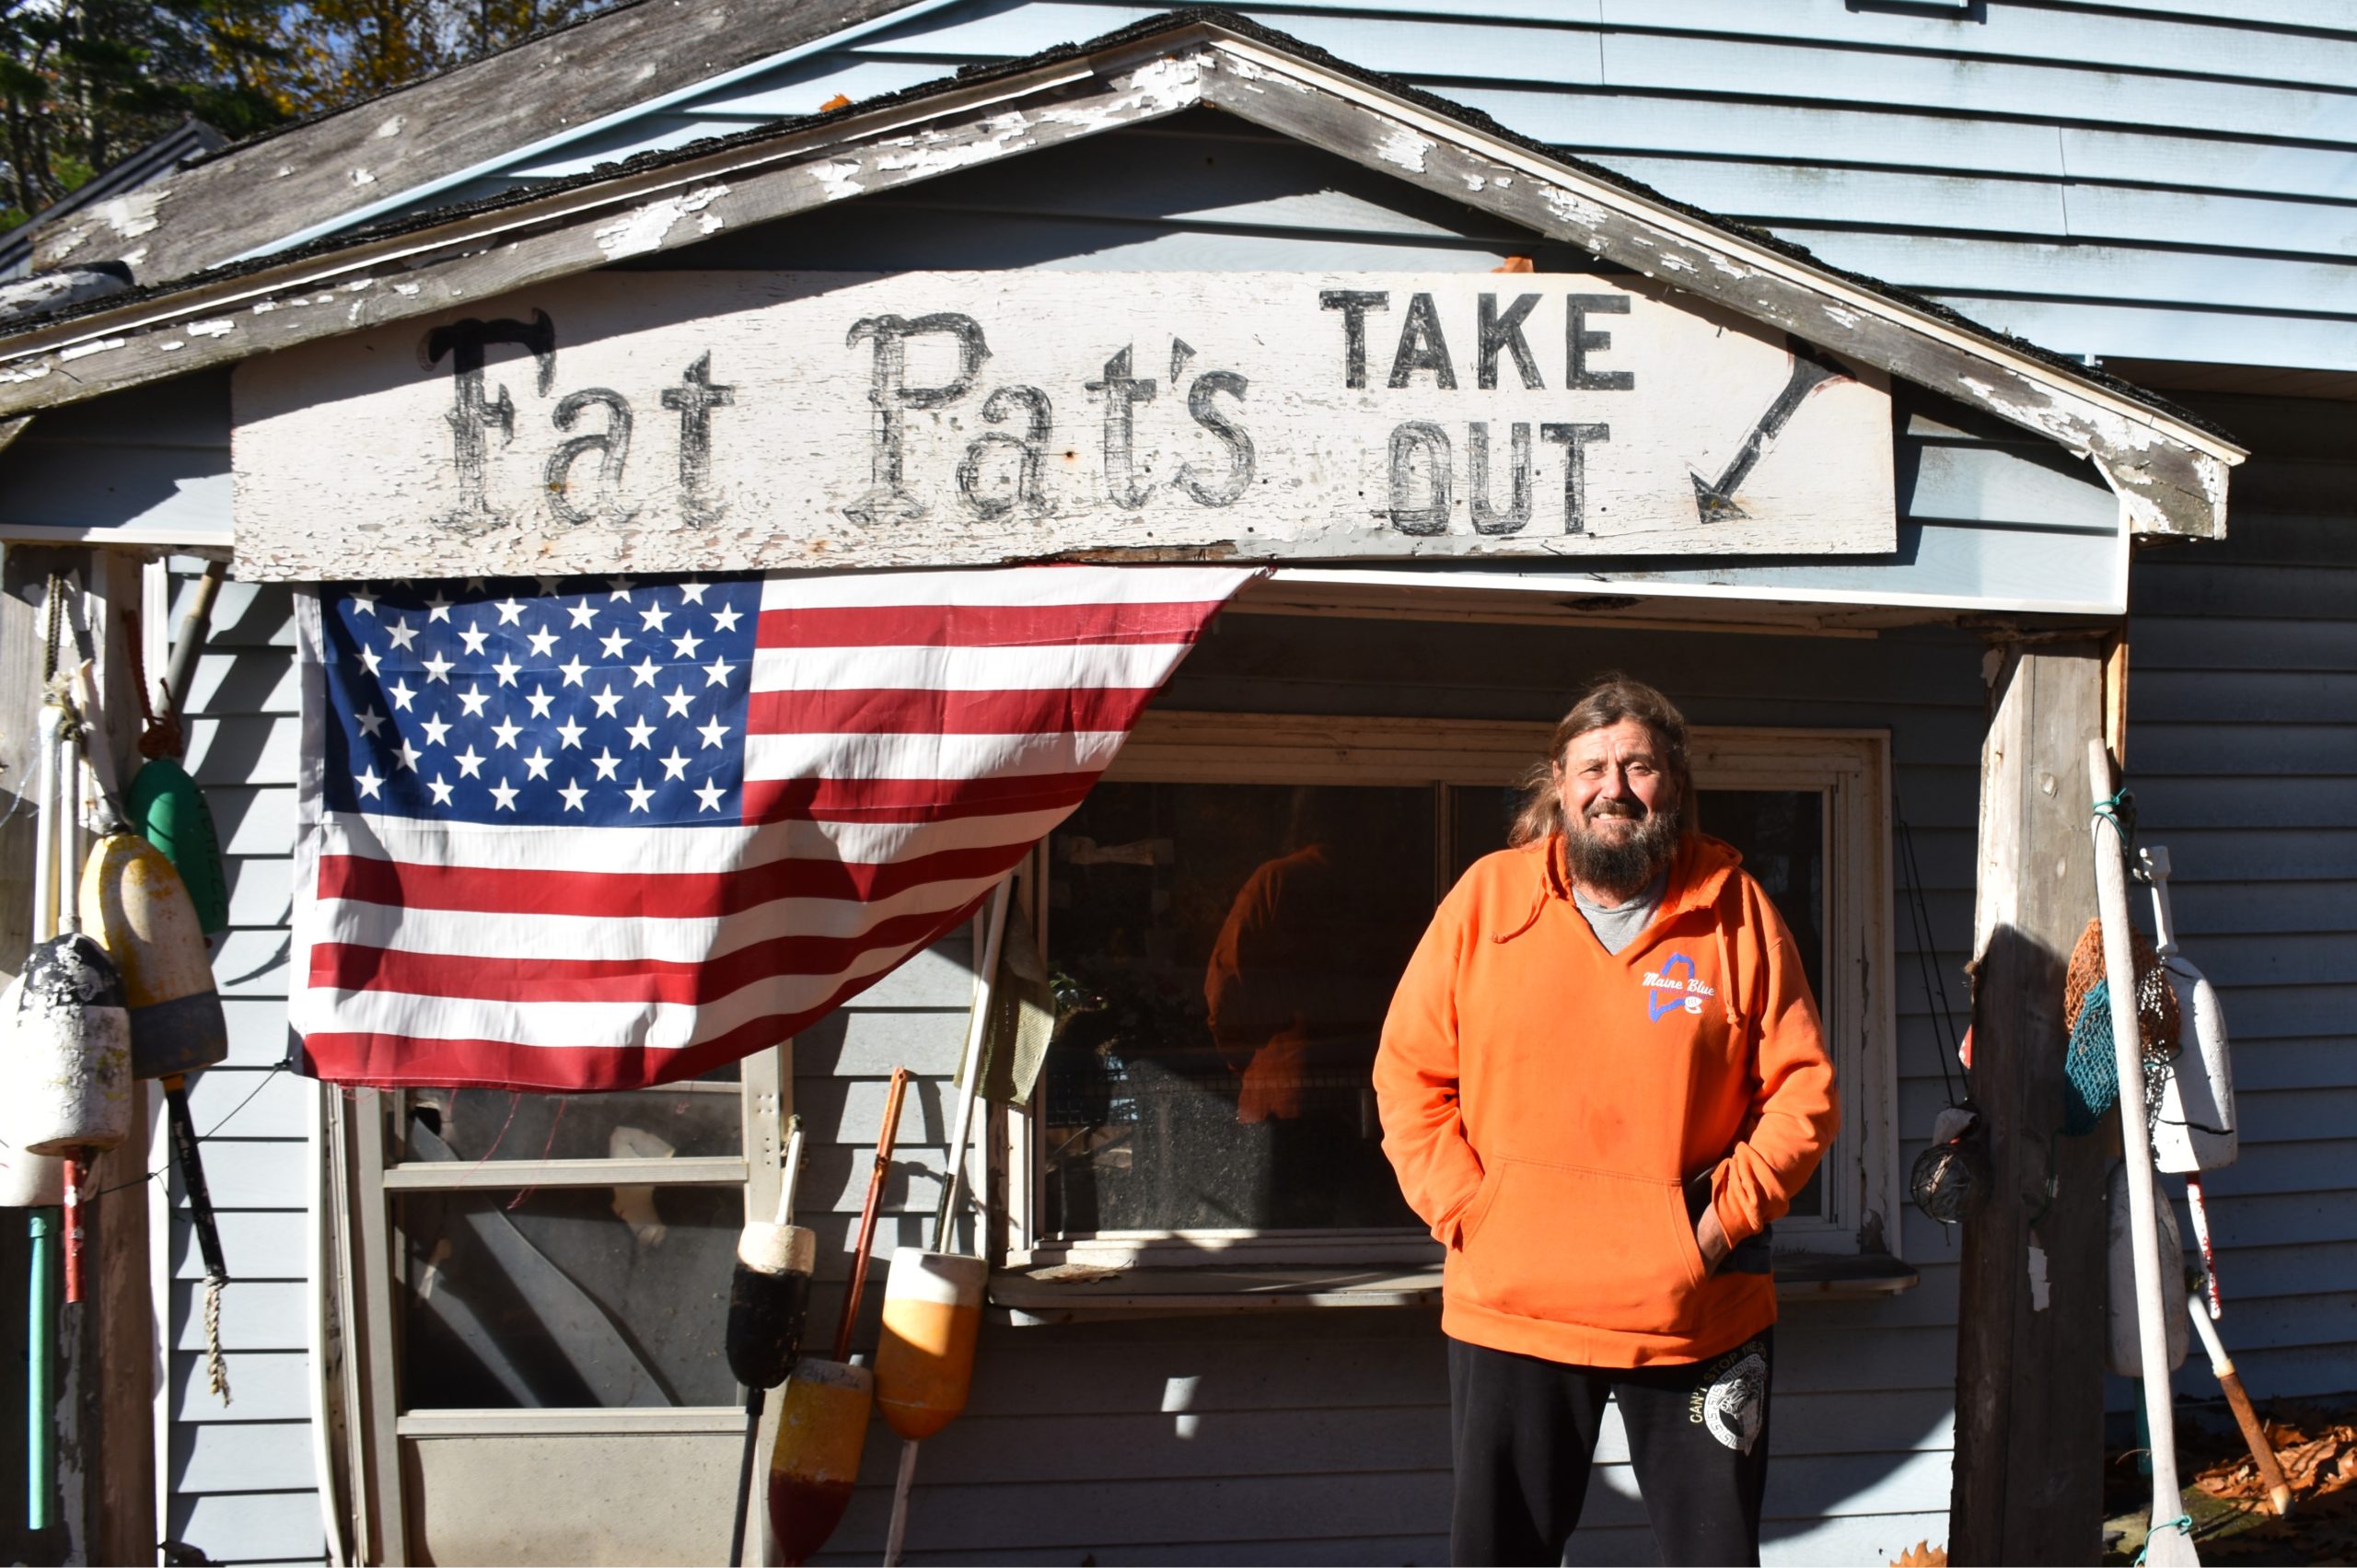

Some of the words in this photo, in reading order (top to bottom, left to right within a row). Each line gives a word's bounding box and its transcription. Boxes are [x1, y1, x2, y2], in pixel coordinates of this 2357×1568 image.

[1318, 289, 1635, 390] TAKE
[418, 308, 736, 531] Fat
[843, 312, 1256, 527] Pat's
[1387, 420, 1610, 537] OUT
[1642, 971, 1684, 990] Maine
[1687, 978, 1715, 996] Blue
[1704, 1353, 1737, 1382] STOP
